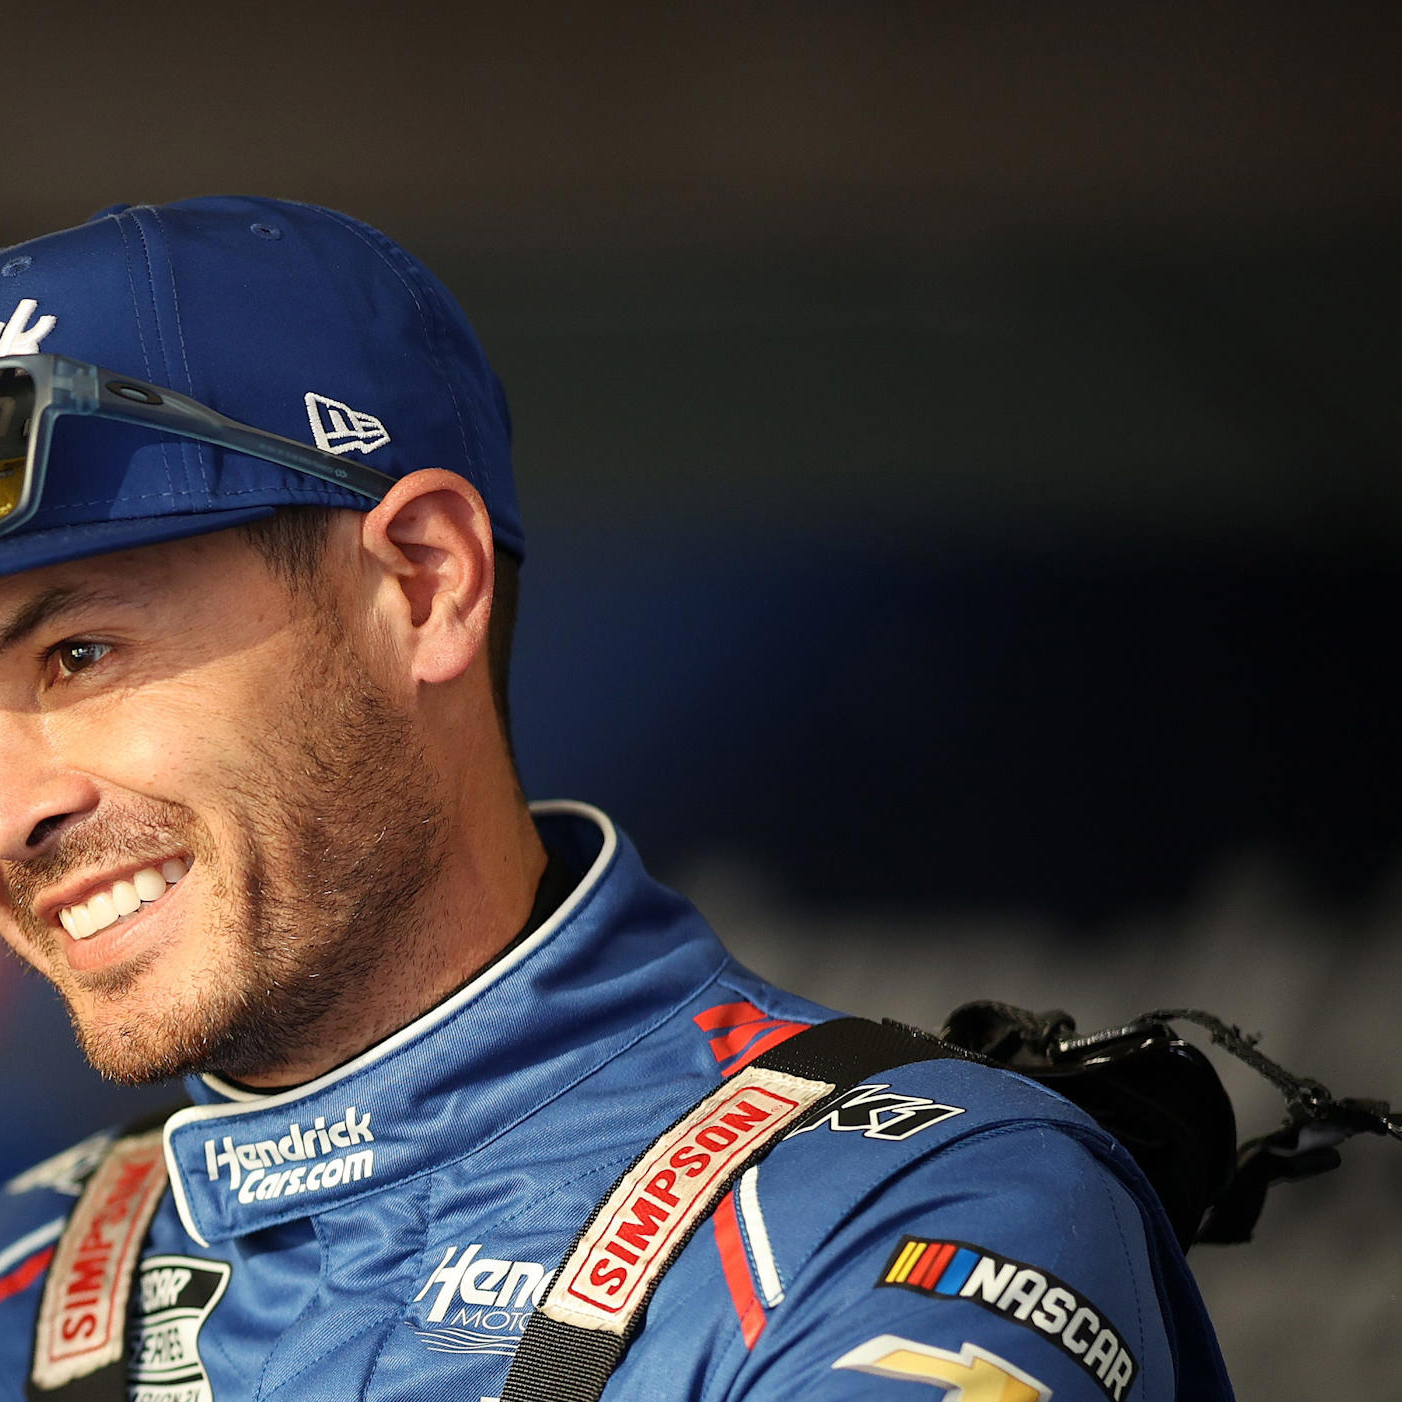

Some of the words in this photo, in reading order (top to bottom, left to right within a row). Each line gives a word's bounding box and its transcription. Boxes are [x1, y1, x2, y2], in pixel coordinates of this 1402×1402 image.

[204, 1105, 375, 1191] Hendrick
[237, 1149, 375, 1205] Cars.com
[589, 1099, 774, 1296] SIMPSON
[413, 1243, 557, 1323] Hen
[958, 1255, 1134, 1402] NASCAR
